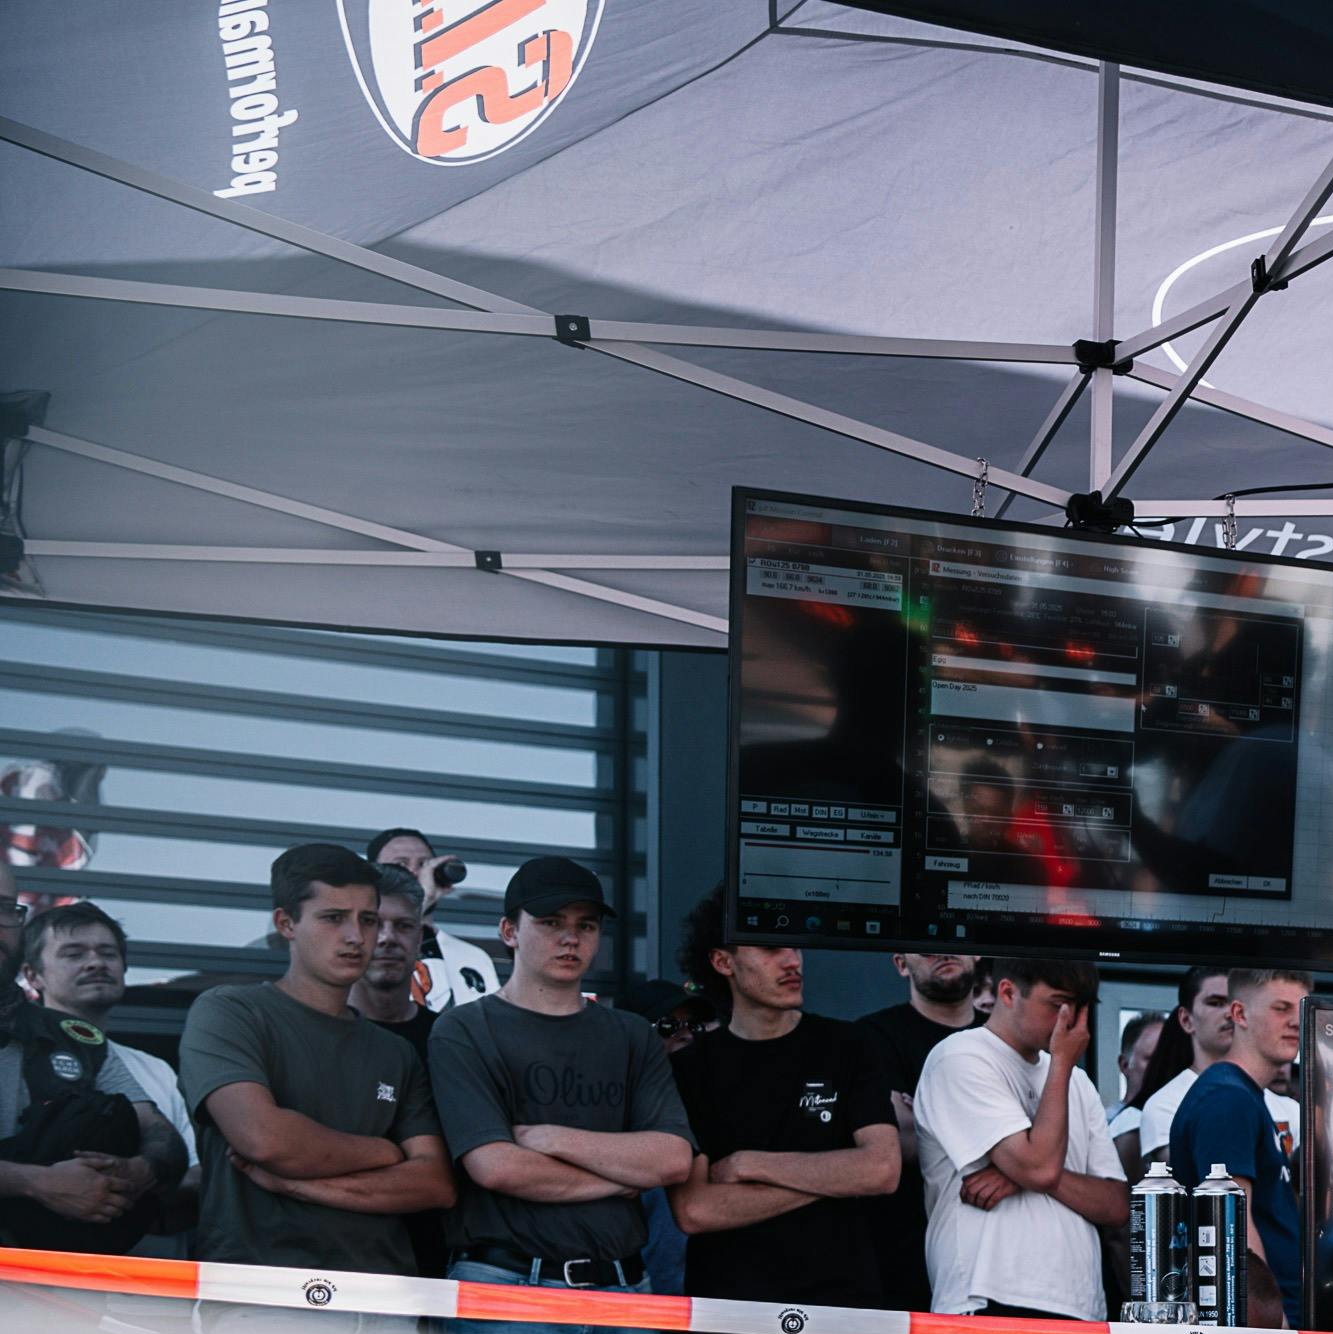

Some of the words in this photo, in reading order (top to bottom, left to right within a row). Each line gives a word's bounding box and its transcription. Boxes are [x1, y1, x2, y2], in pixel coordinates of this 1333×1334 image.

[860, 536, 882, 544] Laden
[943, 565, 972, 576] Messung
[932, 682, 948, 692] Open
[948, 683, 961, 692] Day
[815, 808, 828, 816] DIN
[755, 825, 778, 833] Tabelle
[933, 860, 961, 869] Fahrzeug
[1205, 1310, 1219, 1318] 1950
